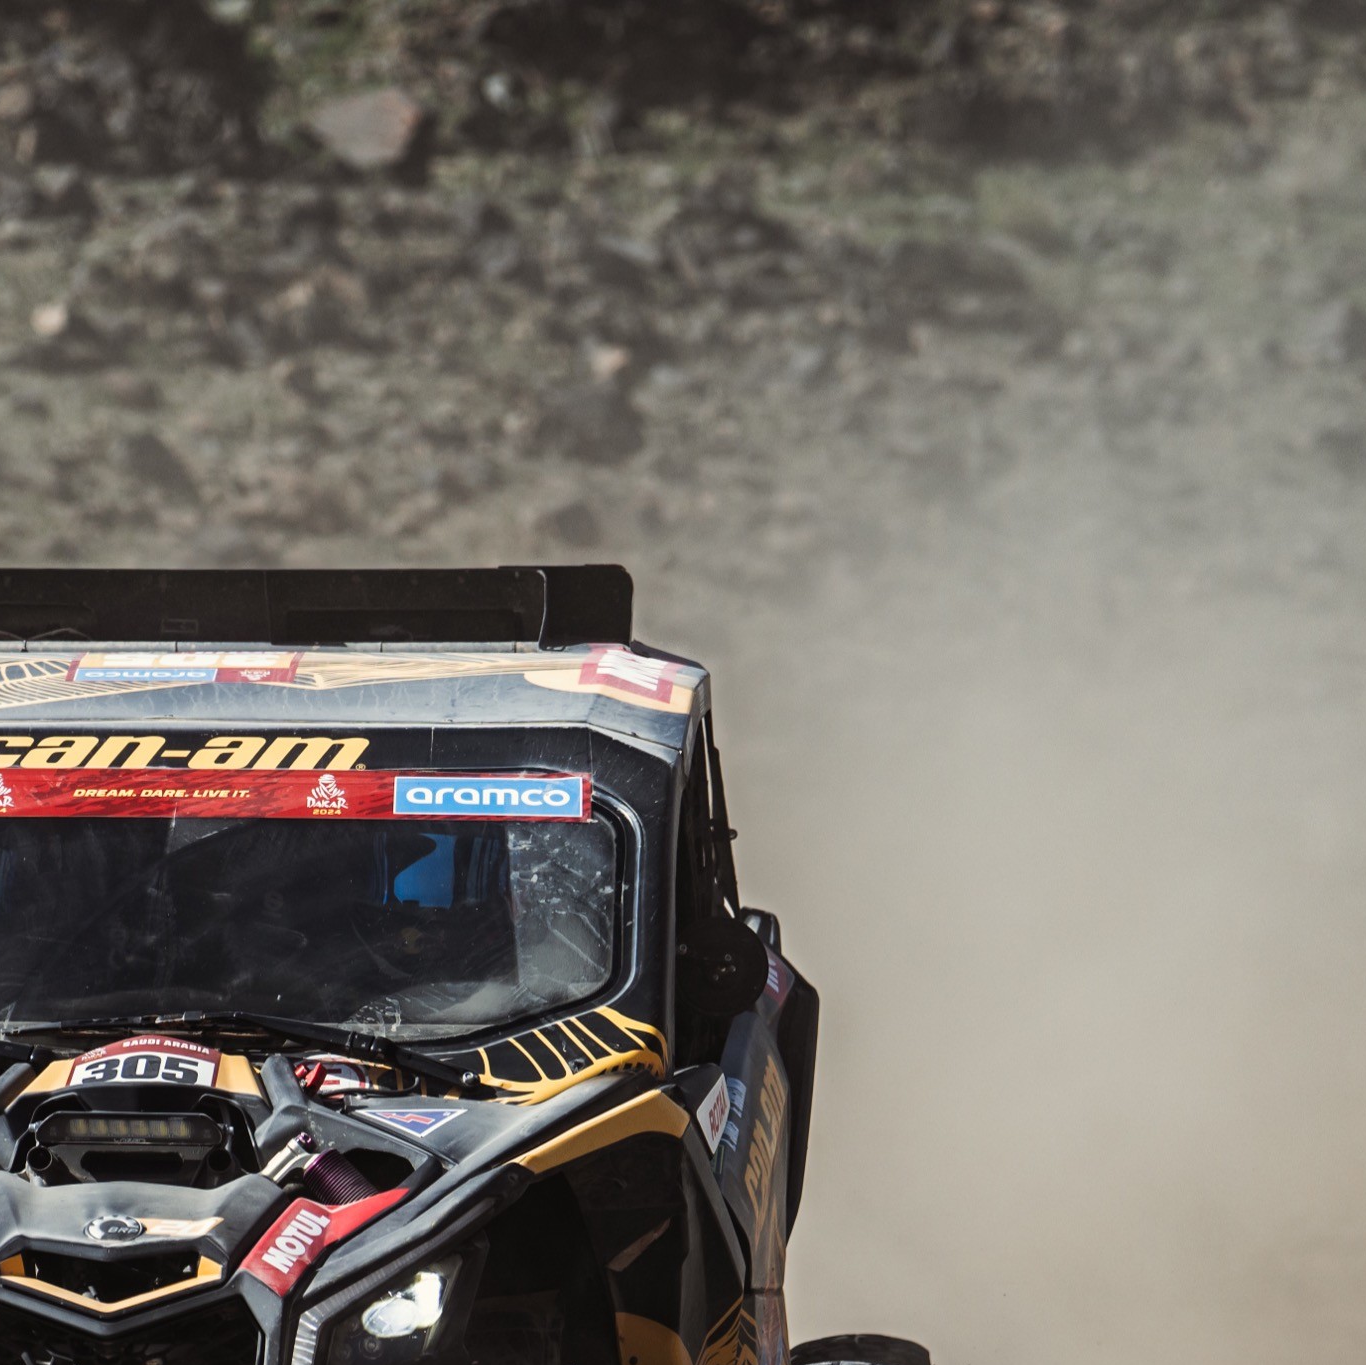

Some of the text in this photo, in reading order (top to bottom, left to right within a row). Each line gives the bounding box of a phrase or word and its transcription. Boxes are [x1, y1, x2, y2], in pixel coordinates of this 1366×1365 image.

[84, 670, 207, 678] aramco
[73, 789, 251, 798] DREAM. DARE. LIVE IT.
[406, 787, 571, 807] aramco
[307, 796, 349, 809] DAKAR
[122, 1038, 210, 1055] SAUDI ARABIA
[82, 1054, 199, 1085] 305
[108, 1225, 139, 1234] BRP
[261, 1209, 331, 1275] MOTUL
